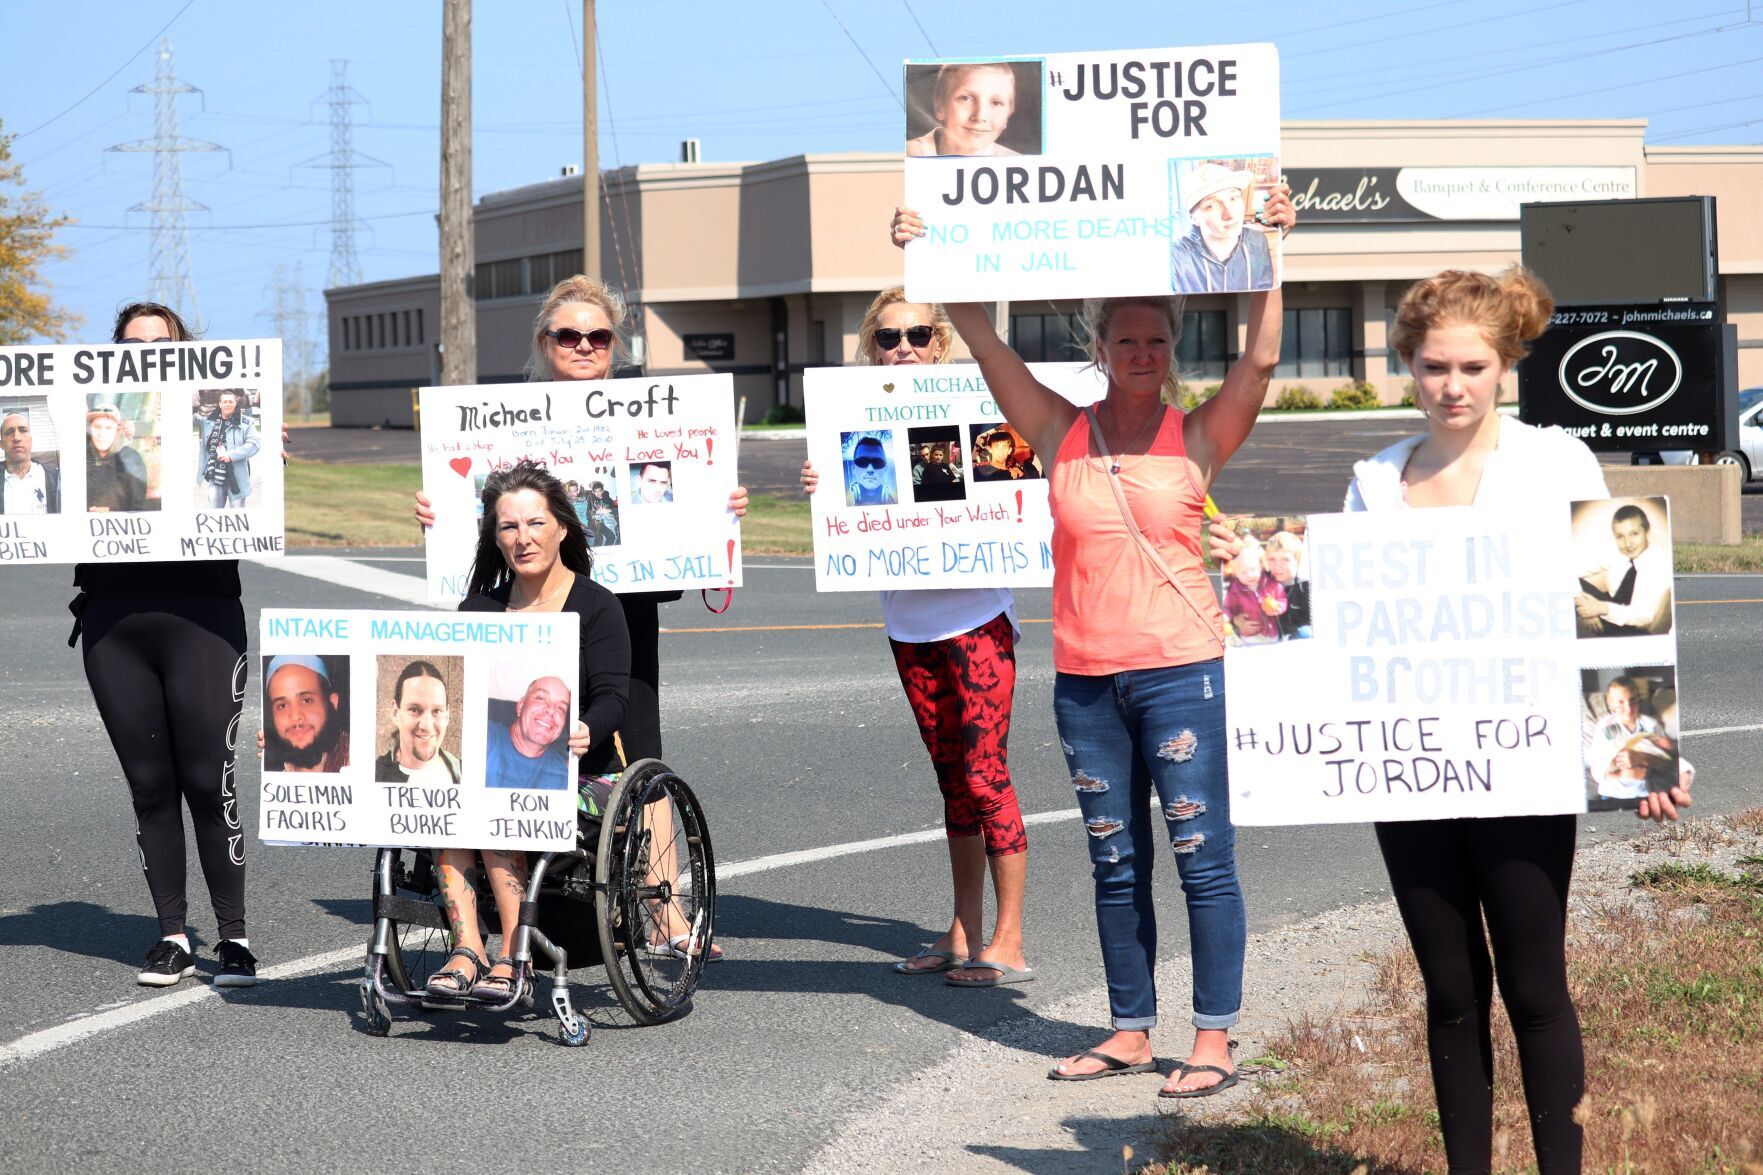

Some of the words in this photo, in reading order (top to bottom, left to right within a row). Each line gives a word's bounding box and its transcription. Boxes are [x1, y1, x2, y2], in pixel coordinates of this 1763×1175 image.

[1049, 59, 1237, 101] #JUSTICE
[1130, 100, 1207, 139] FOR
[942, 163, 1124, 205] JORDAN
[1281, 173, 1390, 211] chael's
[1414, 179, 1474, 198] Banquet
[1478, 179, 1491, 193] &
[1495, 179, 1578, 193] Conference
[1581, 178, 1630, 193] Centre
[930, 223, 969, 244] NO
[992, 219, 1068, 242] MORE
[1078, 217, 1172, 239] DEATHS
[976, 253, 1000, 273] IN
[1021, 251, 1076, 272] JAIL
[1622, 308, 1713, 325] johnmichaels.ca
[912, 376, 990, 393] MICHAE
[585, 384, 680, 419] Croft
[865, 404, 951, 422] TIMOTHY
[638, 430, 648, 439] He
[688, 426, 717, 439] people
[1600, 422, 1612, 437] &
[1617, 424, 1659, 437] event
[1662, 422, 1709, 437] centre
[550, 449, 573, 466] You
[588, 448, 613, 462] We
[626, 446, 664, 460] Love
[89, 517, 152, 537] DAVID
[195, 512, 250, 534] RYAN
[827, 517, 850, 537] He
[857, 511, 892, 532] died
[897, 517, 932, 529] under
[935, 507, 963, 524] Your
[92, 538, 151, 558] COWE
[827, 553, 857, 576] NO
[867, 546, 930, 577] MORE
[942, 541, 1029, 574] DEATHS
[626, 560, 653, 581] IN
[1318, 540, 1434, 590] REST
[1465, 533, 1512, 584] IN
[269, 618, 348, 639] INTAKE
[371, 620, 528, 643] MANAGEMENT
[1336, 591, 1572, 648] PARADISE
[1235, 717, 1443, 755] #JUSTICE
[1475, 715, 1552, 749] FOR
[1322, 757, 1491, 797] JORDAN
[264, 783, 353, 805] SOLEIMAN
[384, 786, 461, 809] TREVOR
[510, 792, 549, 812] RON
[266, 810, 346, 831] FAQIRIS
[390, 813, 457, 836] BURKE
[489, 818, 573, 840] JENKINS
